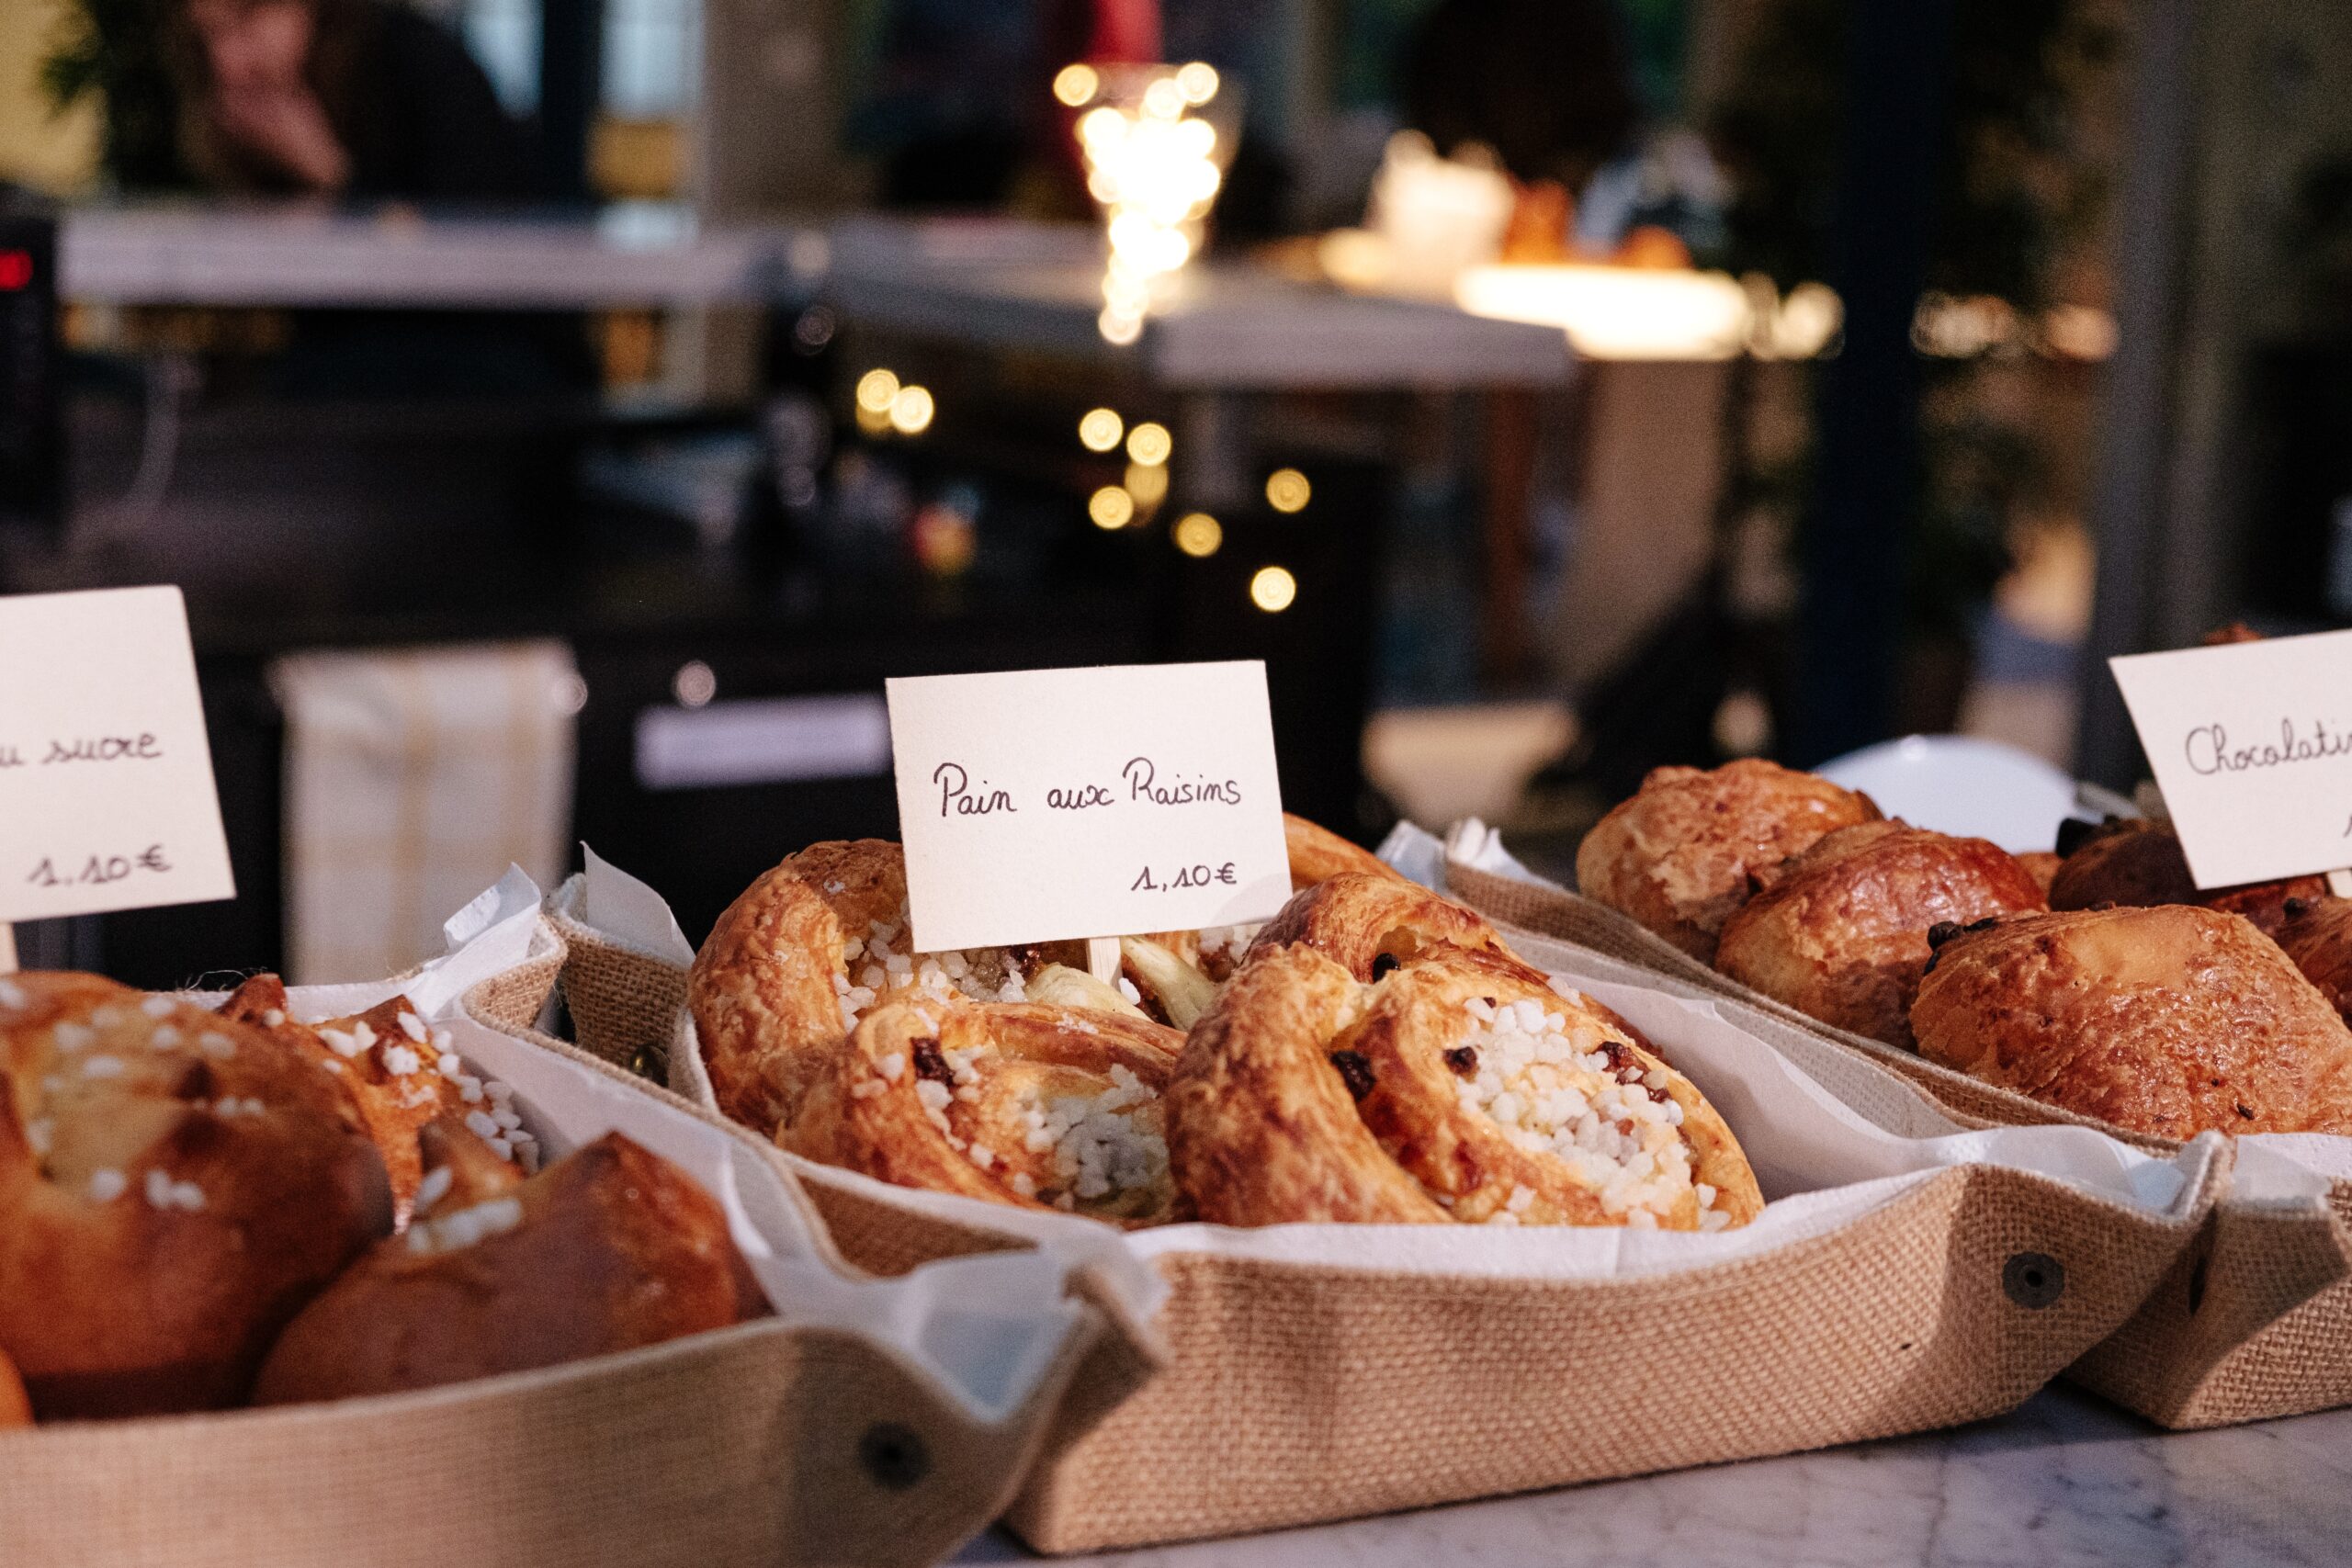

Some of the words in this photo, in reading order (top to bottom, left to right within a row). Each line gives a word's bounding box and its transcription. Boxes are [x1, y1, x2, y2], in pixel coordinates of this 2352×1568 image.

[42, 732, 164, 766] sucre
[933, 761, 1018, 818] Pain
[1046, 784, 1115, 811] aux
[1122, 756, 1241, 807] Raisins
[1130, 861, 1238, 893] 1,10€
